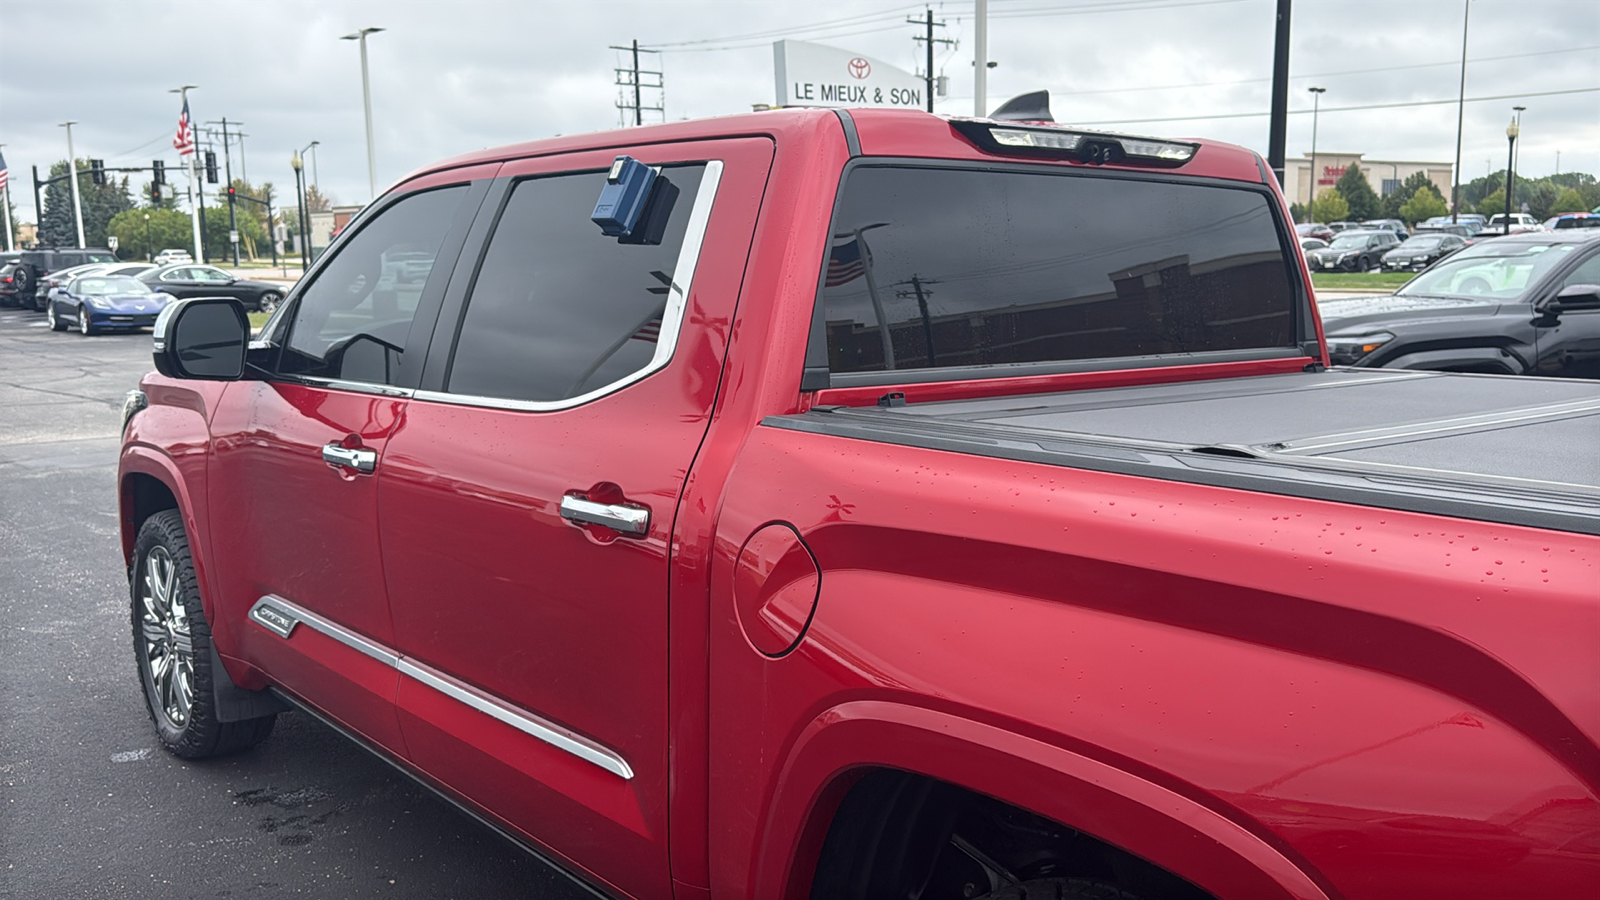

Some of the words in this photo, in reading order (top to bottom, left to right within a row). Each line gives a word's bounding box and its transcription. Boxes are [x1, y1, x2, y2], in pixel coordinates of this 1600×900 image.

[795, 82, 814, 100] LE
[821, 84, 867, 103] MIEUX
[873, 87, 883, 104] &
[890, 87, 921, 106] SON
